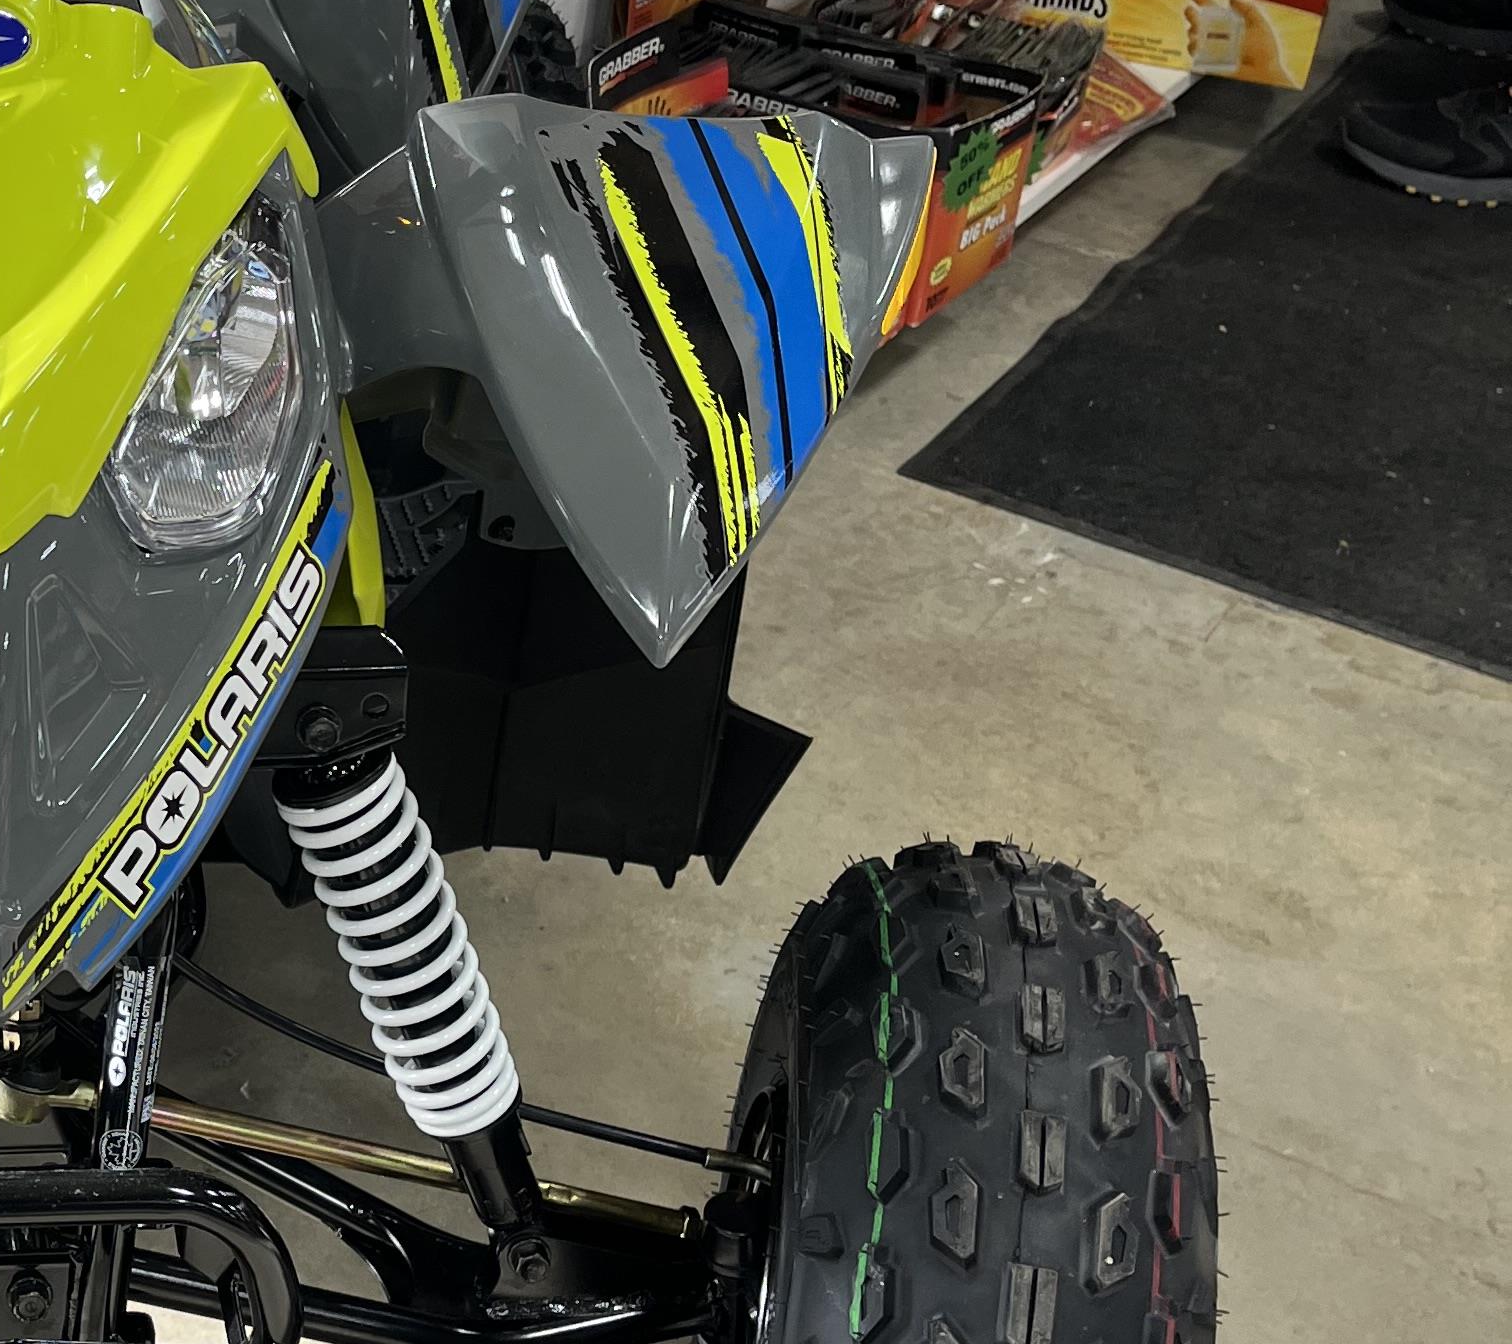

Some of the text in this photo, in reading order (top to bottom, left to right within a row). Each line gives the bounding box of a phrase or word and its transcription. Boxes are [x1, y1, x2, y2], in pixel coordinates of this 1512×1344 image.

[599, 36, 662, 86] GRABBER
[959, 140, 990, 169] 50%
[979, 147, 1023, 193] AND
[957, 169, 985, 197] OFF
[959, 224, 981, 251] BIG
[103, 552, 321, 908] POLARIS
[143, 965, 156, 997] TAIWAN
[112, 965, 137, 1057] POLARIS
